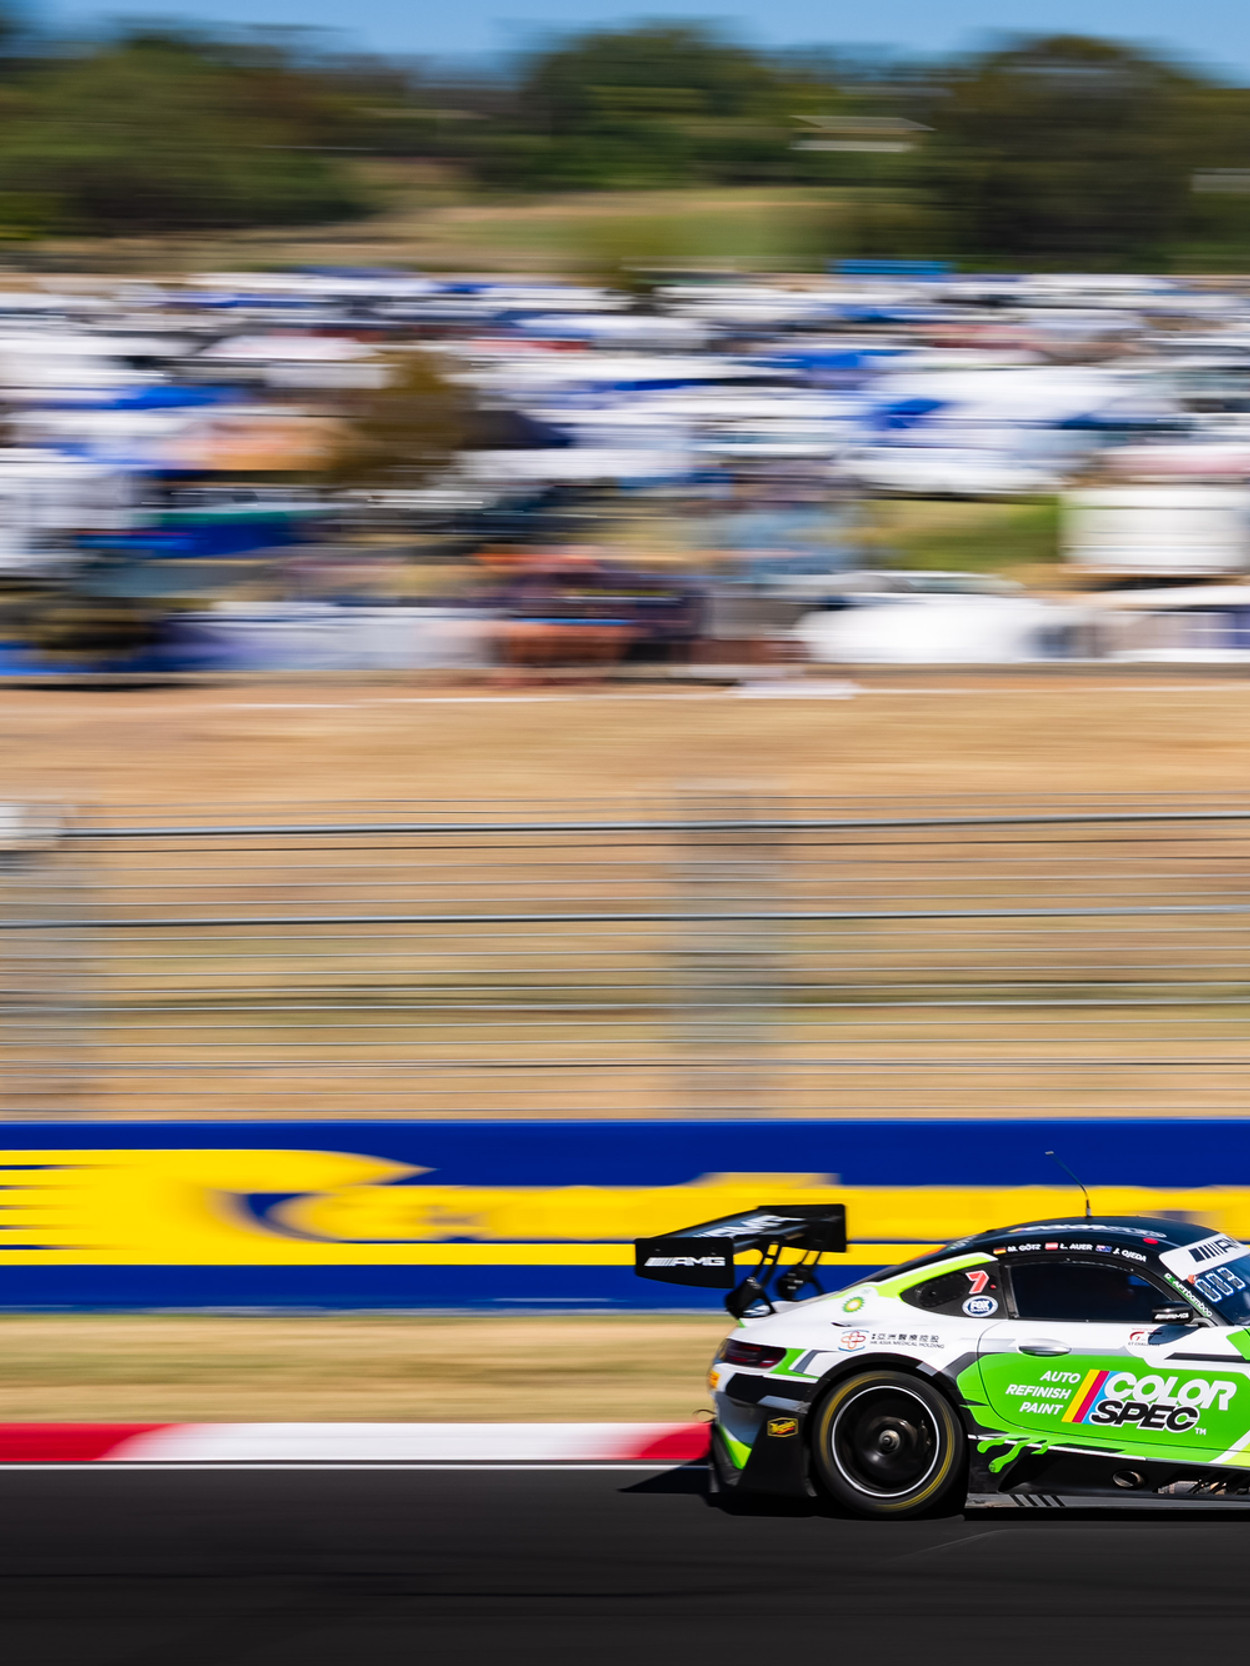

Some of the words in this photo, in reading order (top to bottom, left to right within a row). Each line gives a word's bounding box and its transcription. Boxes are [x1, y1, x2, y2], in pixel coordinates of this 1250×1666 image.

[669, 1257, 726, 1266] AMG
[1121, 1249, 1147, 1262] OJEDA
[1040, 1370, 1081, 1384] AUTO
[1005, 1384, 1072, 1399] REFINISH
[1103, 1372, 1238, 1411] COLOR
[1019, 1401, 1064, 1415] PAINT
[1090, 1400, 1199, 1432] SPEC
